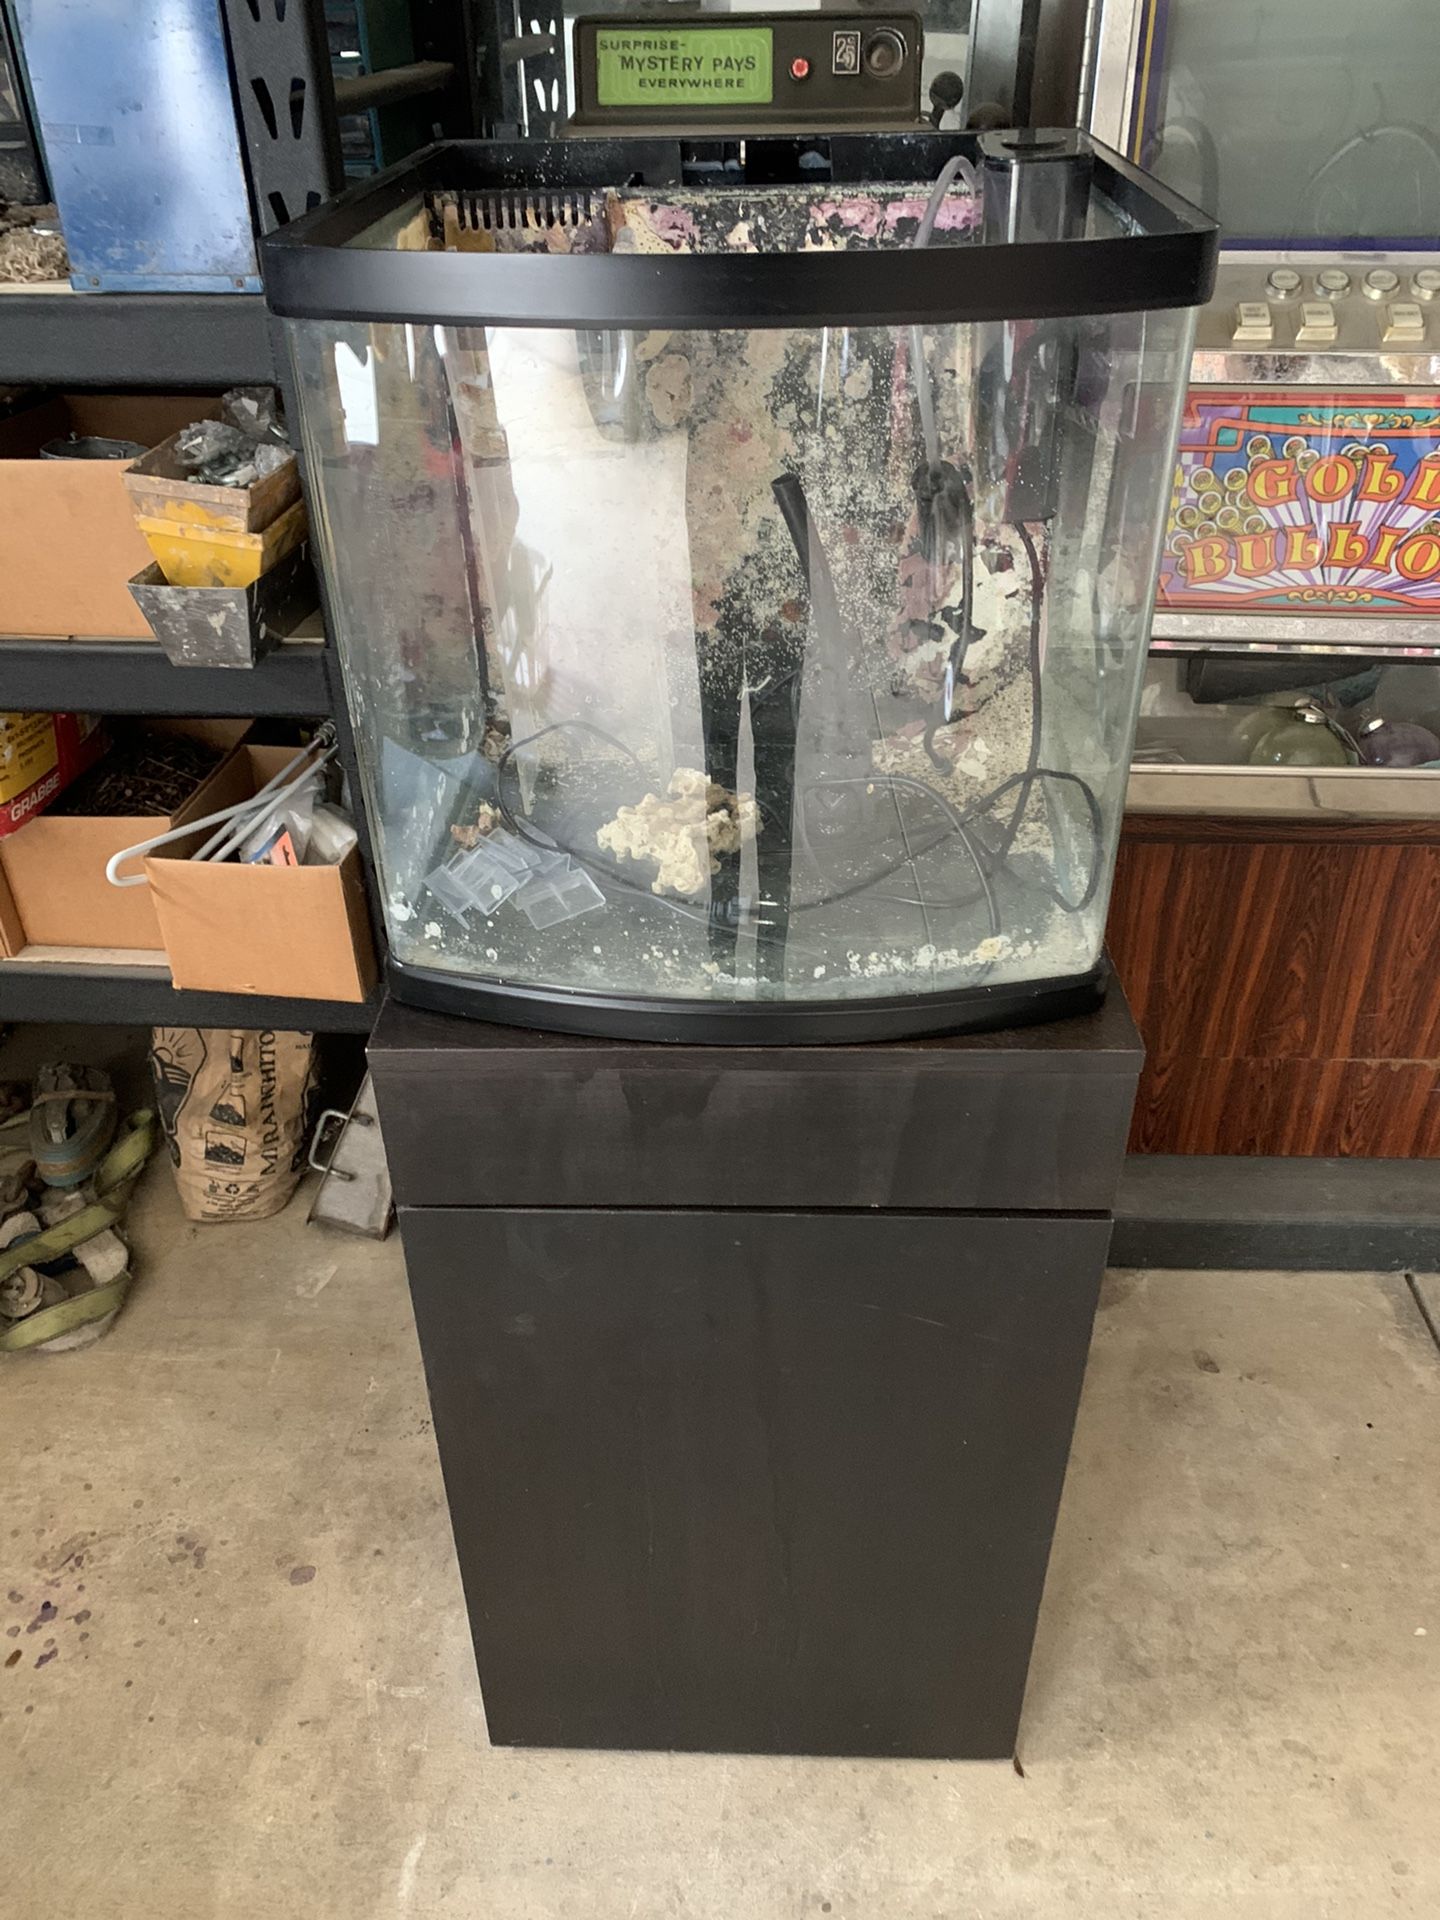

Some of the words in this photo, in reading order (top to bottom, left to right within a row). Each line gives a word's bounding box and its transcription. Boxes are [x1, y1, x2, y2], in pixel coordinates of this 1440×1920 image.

[619, 54, 704, 72] MYSTERY
[712, 54, 757, 72] PAYS
[638, 77, 745, 89] EVERYWHERE
